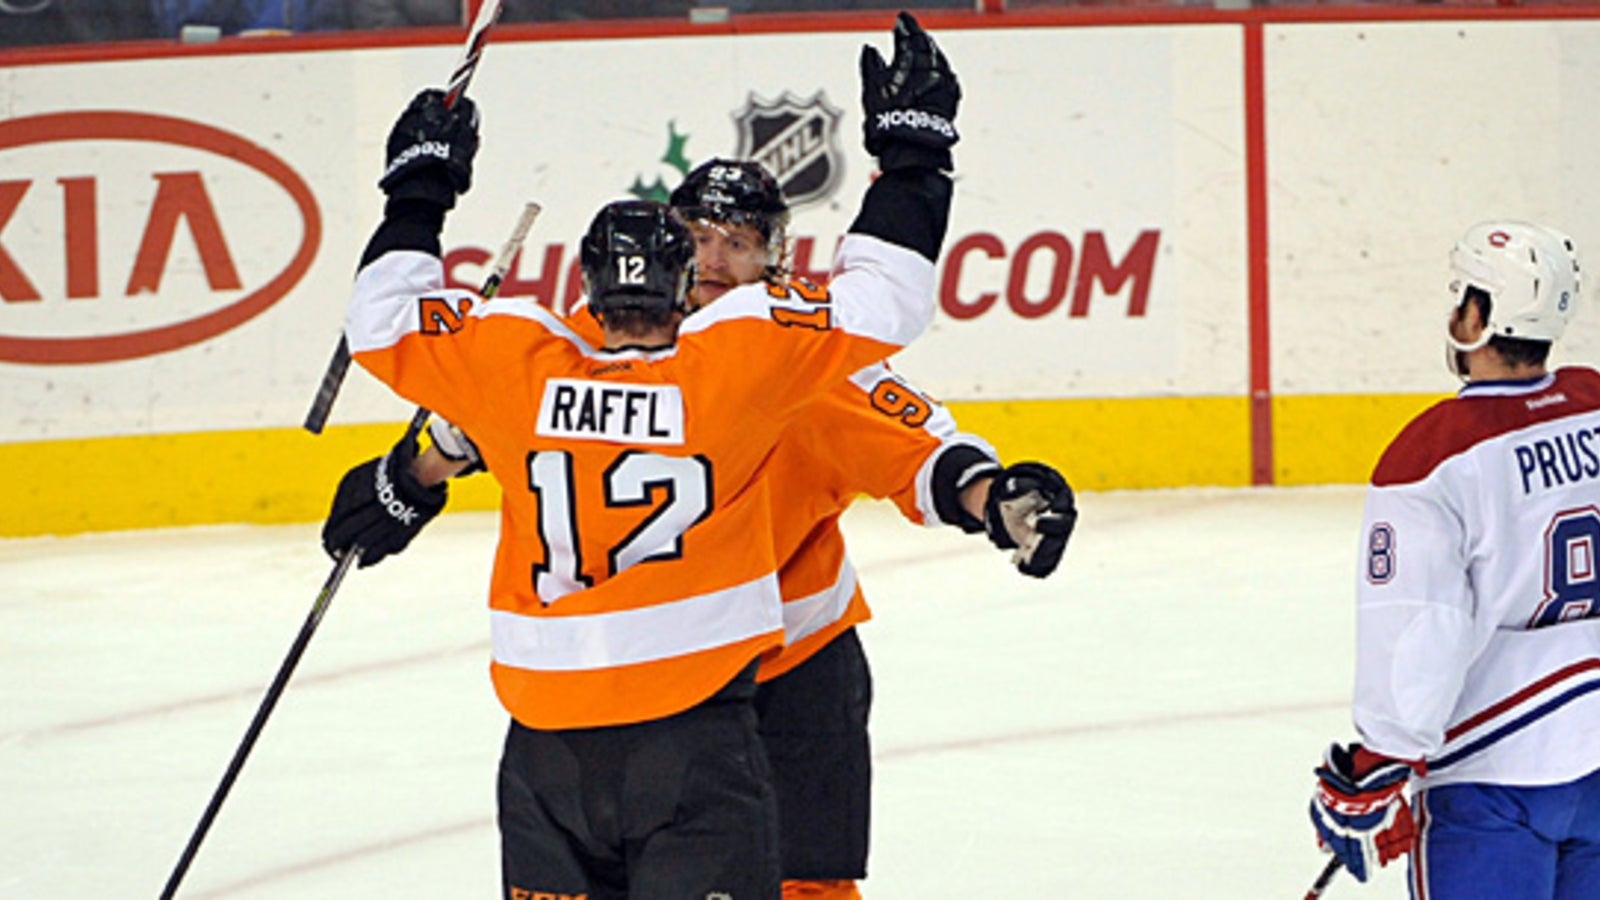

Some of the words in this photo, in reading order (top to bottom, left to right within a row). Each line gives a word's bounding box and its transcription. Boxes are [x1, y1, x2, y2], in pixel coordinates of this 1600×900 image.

[875, 109, 956, 138] Reebok
[763, 124, 823, 178] NHL
[617, 255, 648, 285] 12
[1557, 291, 1570, 312] 8
[551, 385, 671, 437] RAFFL
[869, 376, 943, 429] 9
[526, 448, 715, 608] 12
[1366, 520, 1397, 586] 8
